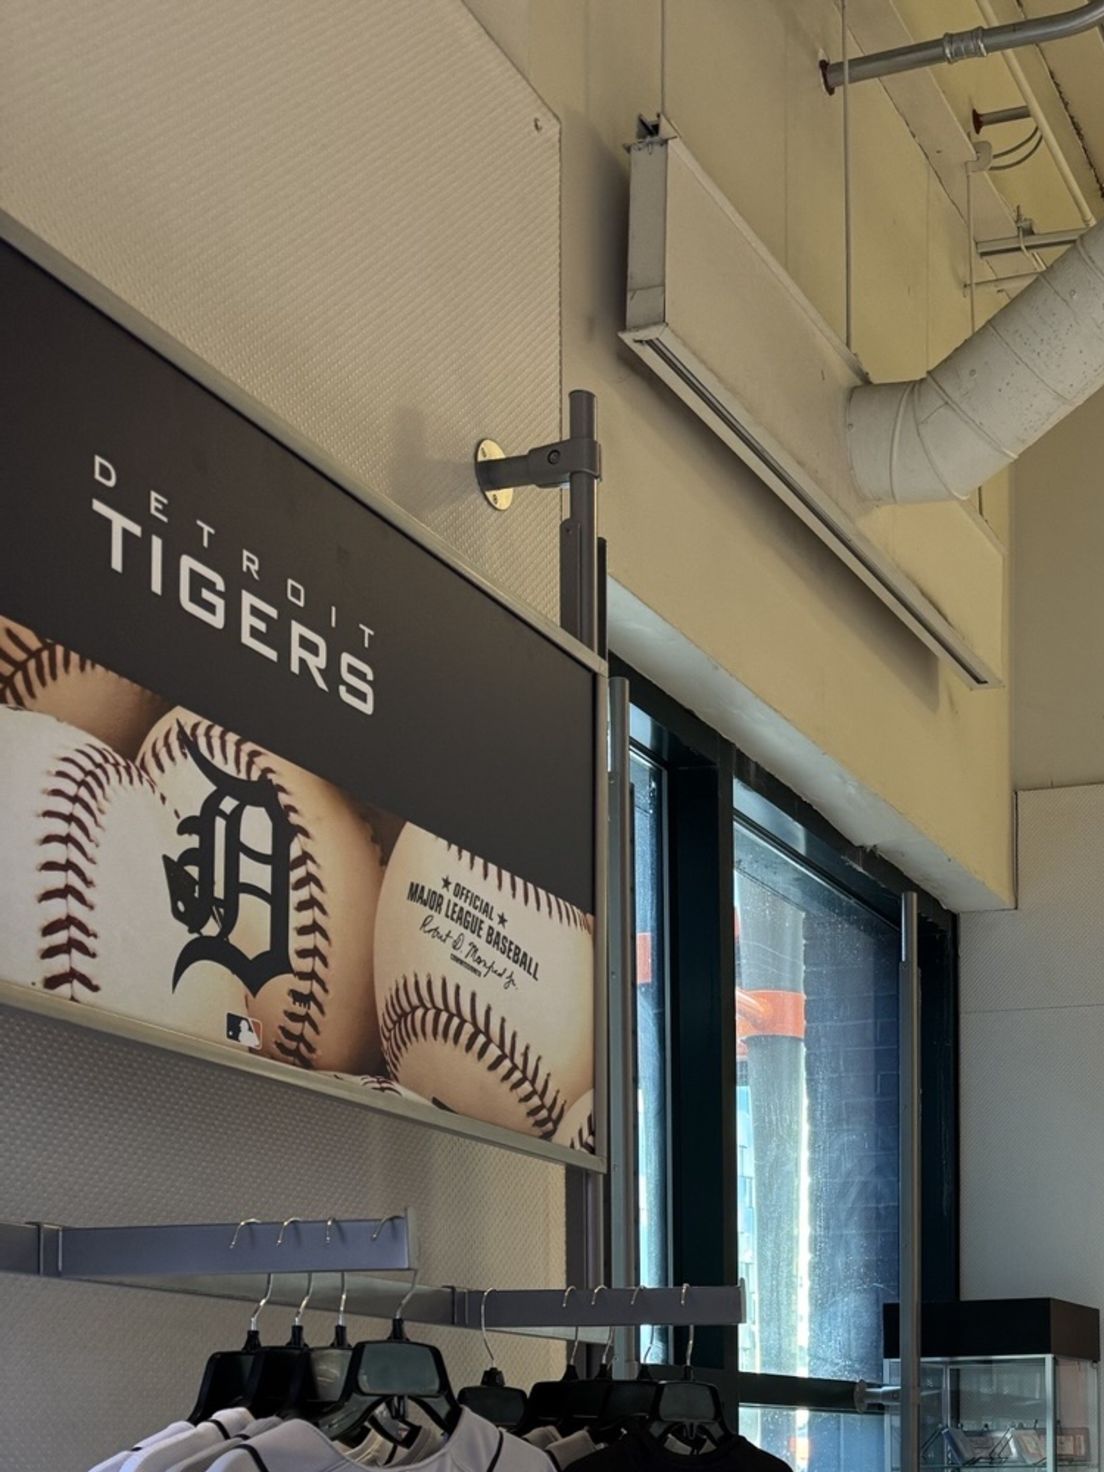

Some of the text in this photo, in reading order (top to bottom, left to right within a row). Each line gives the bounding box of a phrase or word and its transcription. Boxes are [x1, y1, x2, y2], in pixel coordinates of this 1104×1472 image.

[92, 498, 374, 716] TIGERS
[94, 455, 374, 649] DETROIT
[407, 881, 444, 915] MAJOR
[445, 898, 485, 939] LEAGUE
[485, 925, 539, 982] BASEBALL
[453, 882, 494, 921] OFFICIAL
